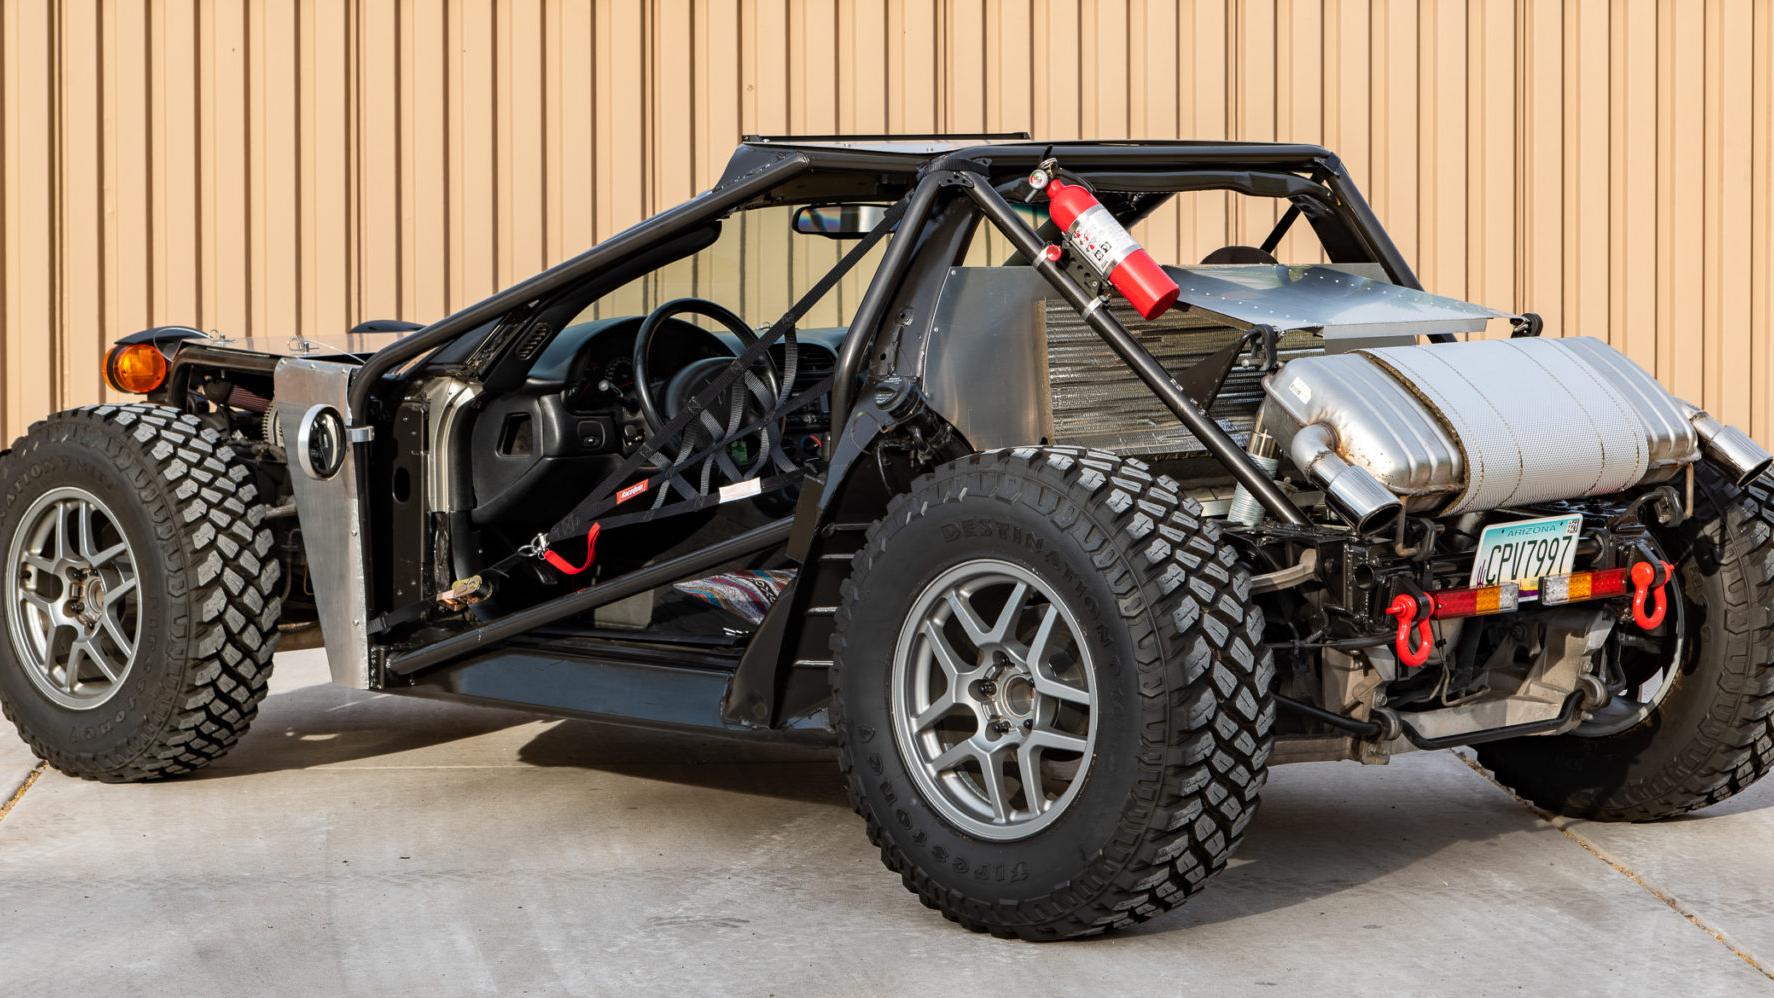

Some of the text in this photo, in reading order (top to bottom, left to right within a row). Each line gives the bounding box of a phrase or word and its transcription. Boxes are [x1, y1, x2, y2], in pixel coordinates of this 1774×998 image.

[1507, 525, 1556, 537] ARIZONA
[940, 519, 1113, 648] DESTINATION
[1485, 535, 1573, 585] CPV7997
